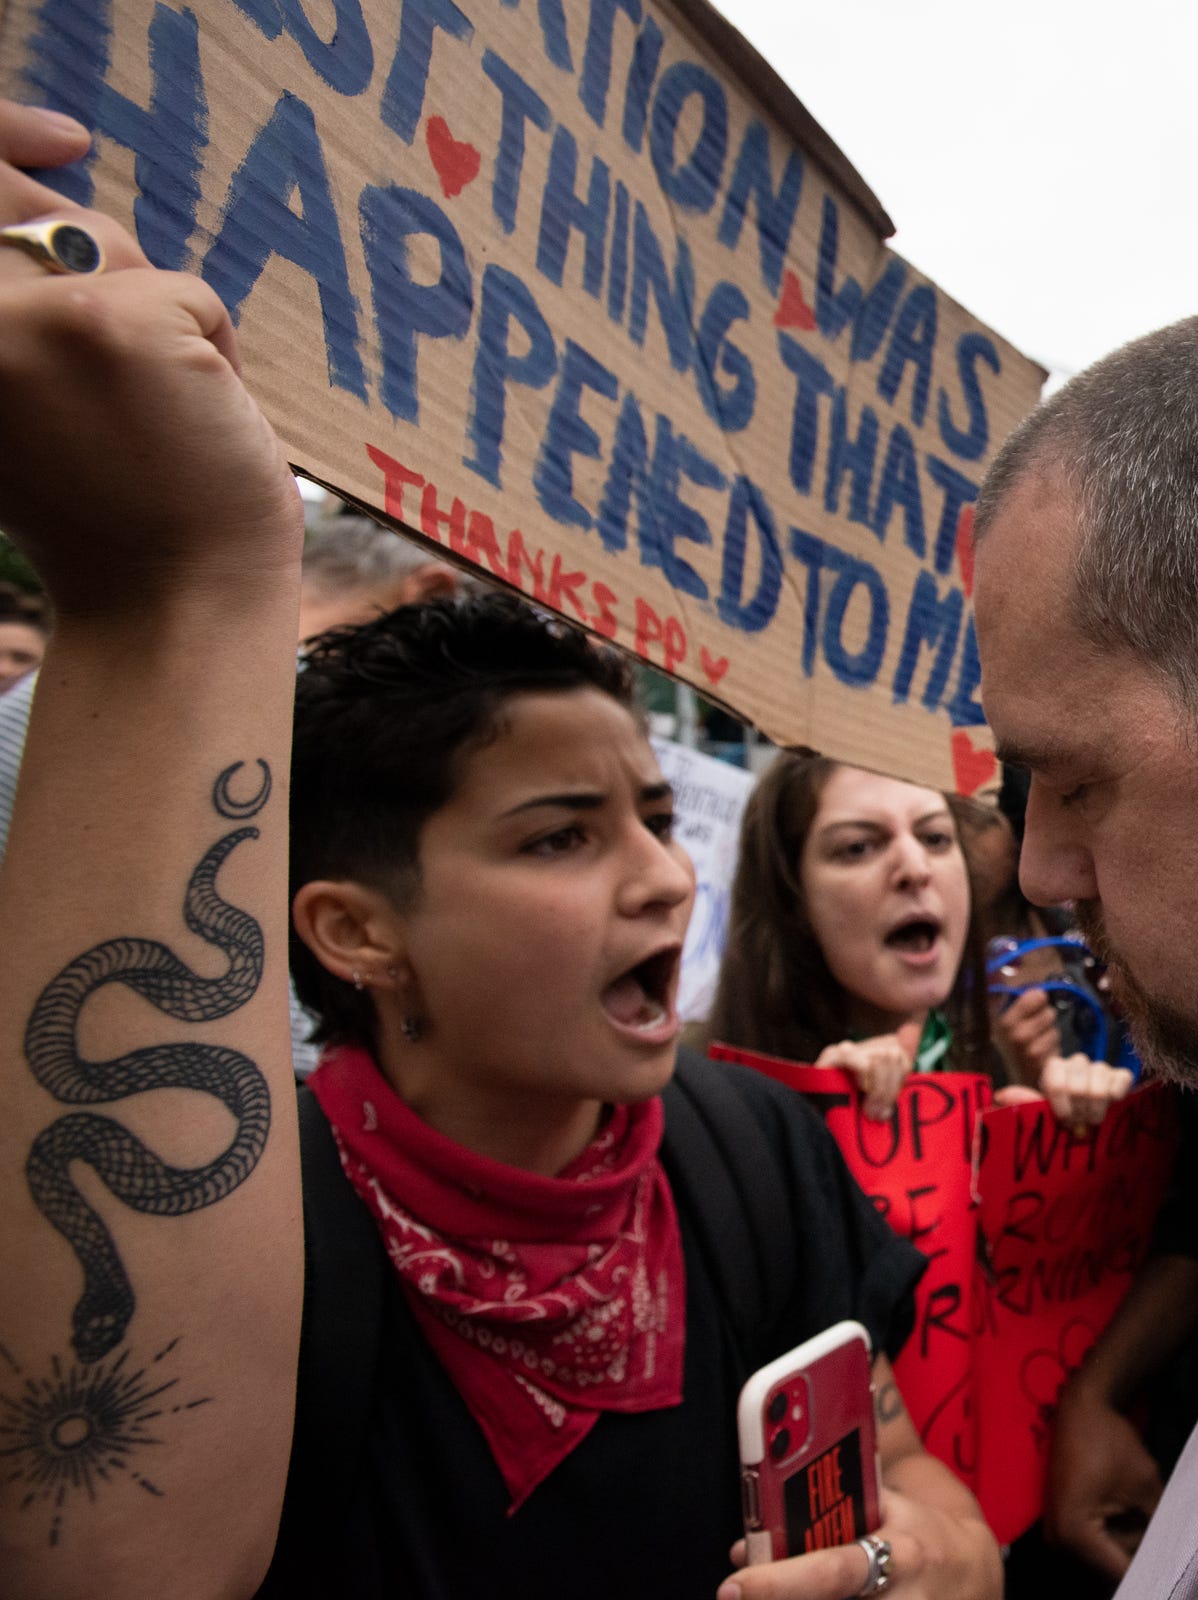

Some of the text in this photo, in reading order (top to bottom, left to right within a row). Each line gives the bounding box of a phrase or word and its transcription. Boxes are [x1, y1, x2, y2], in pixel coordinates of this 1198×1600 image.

[22, 0, 784, 634] HAPPENED
[788, 522, 891, 691] TO
[481, 46, 757, 433] THING
[777, 330, 981, 576] THAT
[814, 194, 1001, 461] WAS
[364, 441, 688, 676] THANKS PP
